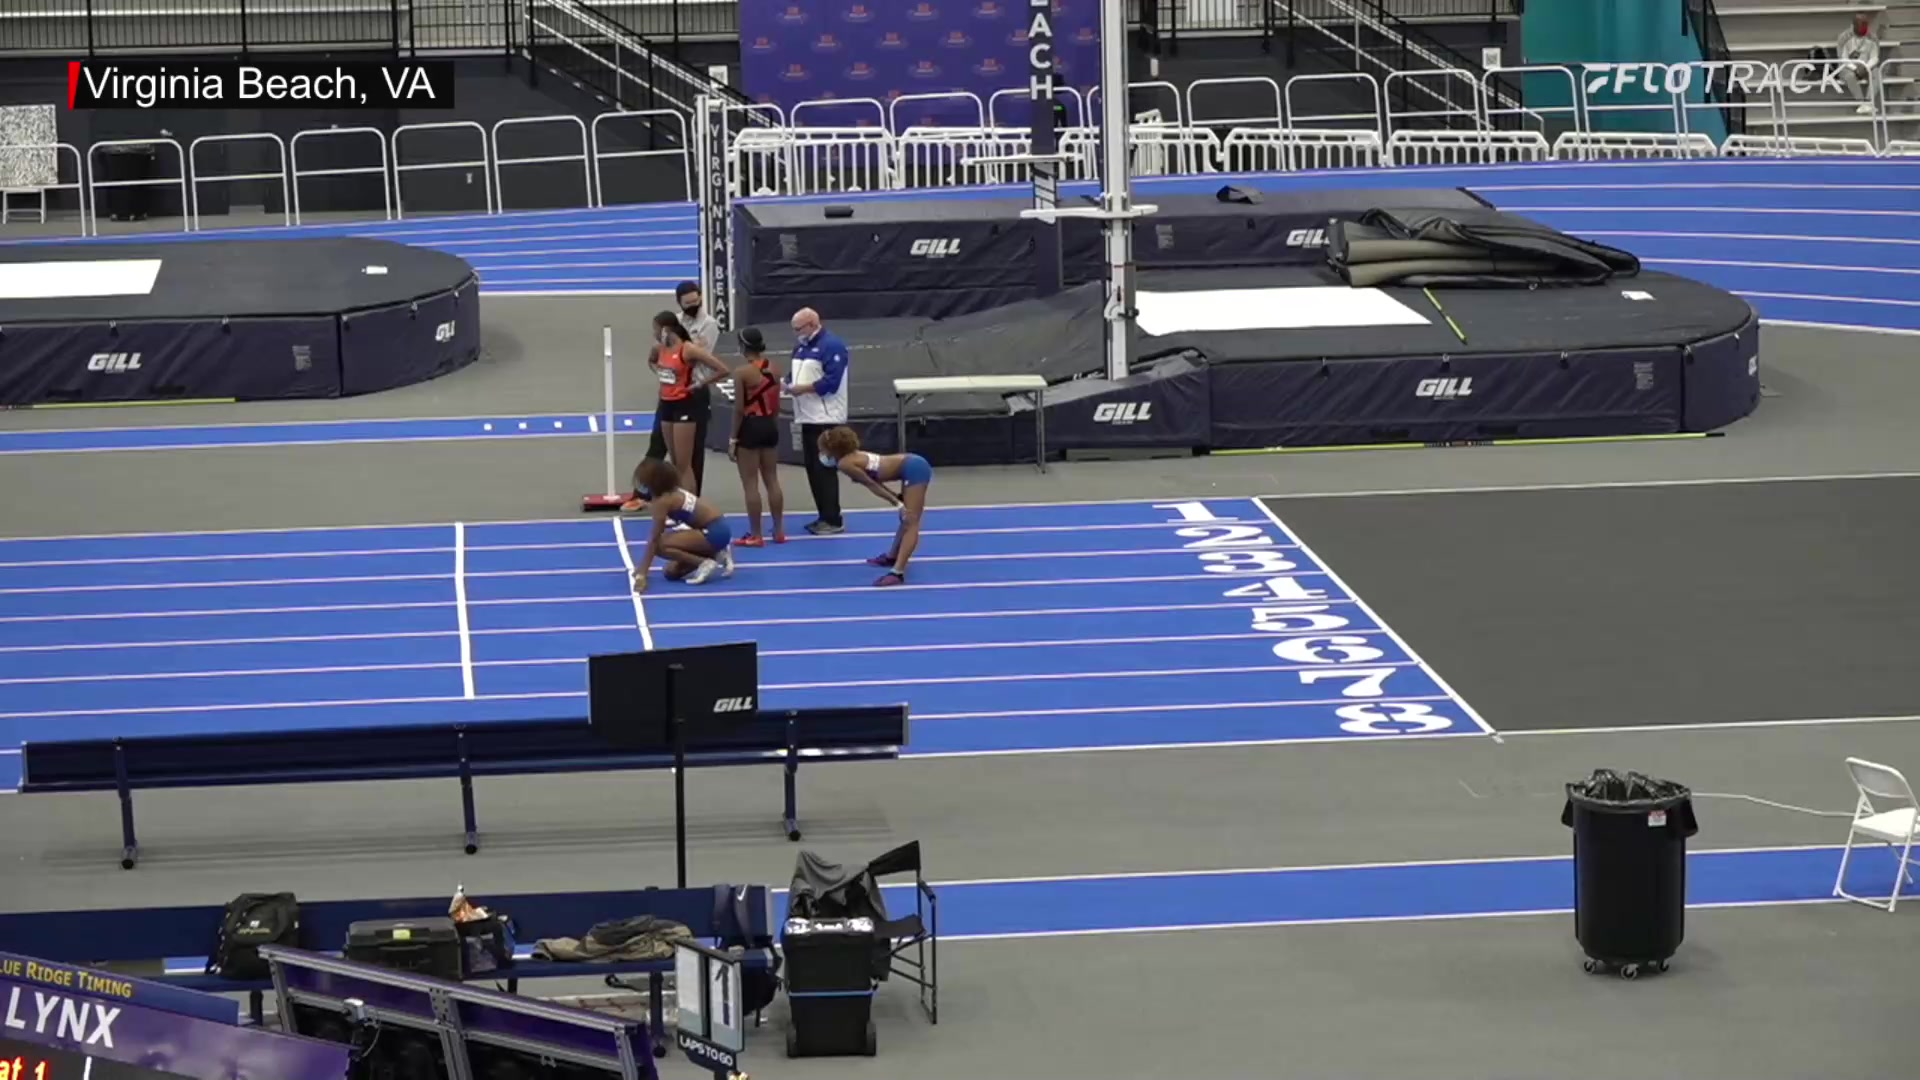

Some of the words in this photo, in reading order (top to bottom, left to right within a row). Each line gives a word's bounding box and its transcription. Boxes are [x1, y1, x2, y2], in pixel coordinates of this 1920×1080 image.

[1028, 0, 1053, 100] ACH
[710, 124, 723, 251] VIRGINIA
[909, 238, 960, 255] GILL
[87, 352, 141, 371] GILL
[1415, 377, 1472, 397] GILL
[1093, 402, 1152, 422] GILL
[1152, 501, 1238, 522] 1
[1175, 525, 1273, 548] 2
[1198, 550, 1297, 573] 3
[1223, 576, 1328, 600] 4
[1251, 605, 1349, 631] 5
[1272, 635, 1384, 663] 6
[1299, 667, 1396, 697] 7
[713, 696, 752, 713] GILL
[1335, 703, 1452, 733] 8
[0, 959, 22, 976] UE
[26, 961, 72, 986] RIDGE
[78, 970, 132, 998] TIMING
[5, 986, 121, 1048] LYNX
[704, 1044, 718, 1060] TO
[719, 1052, 733, 1066] GO
